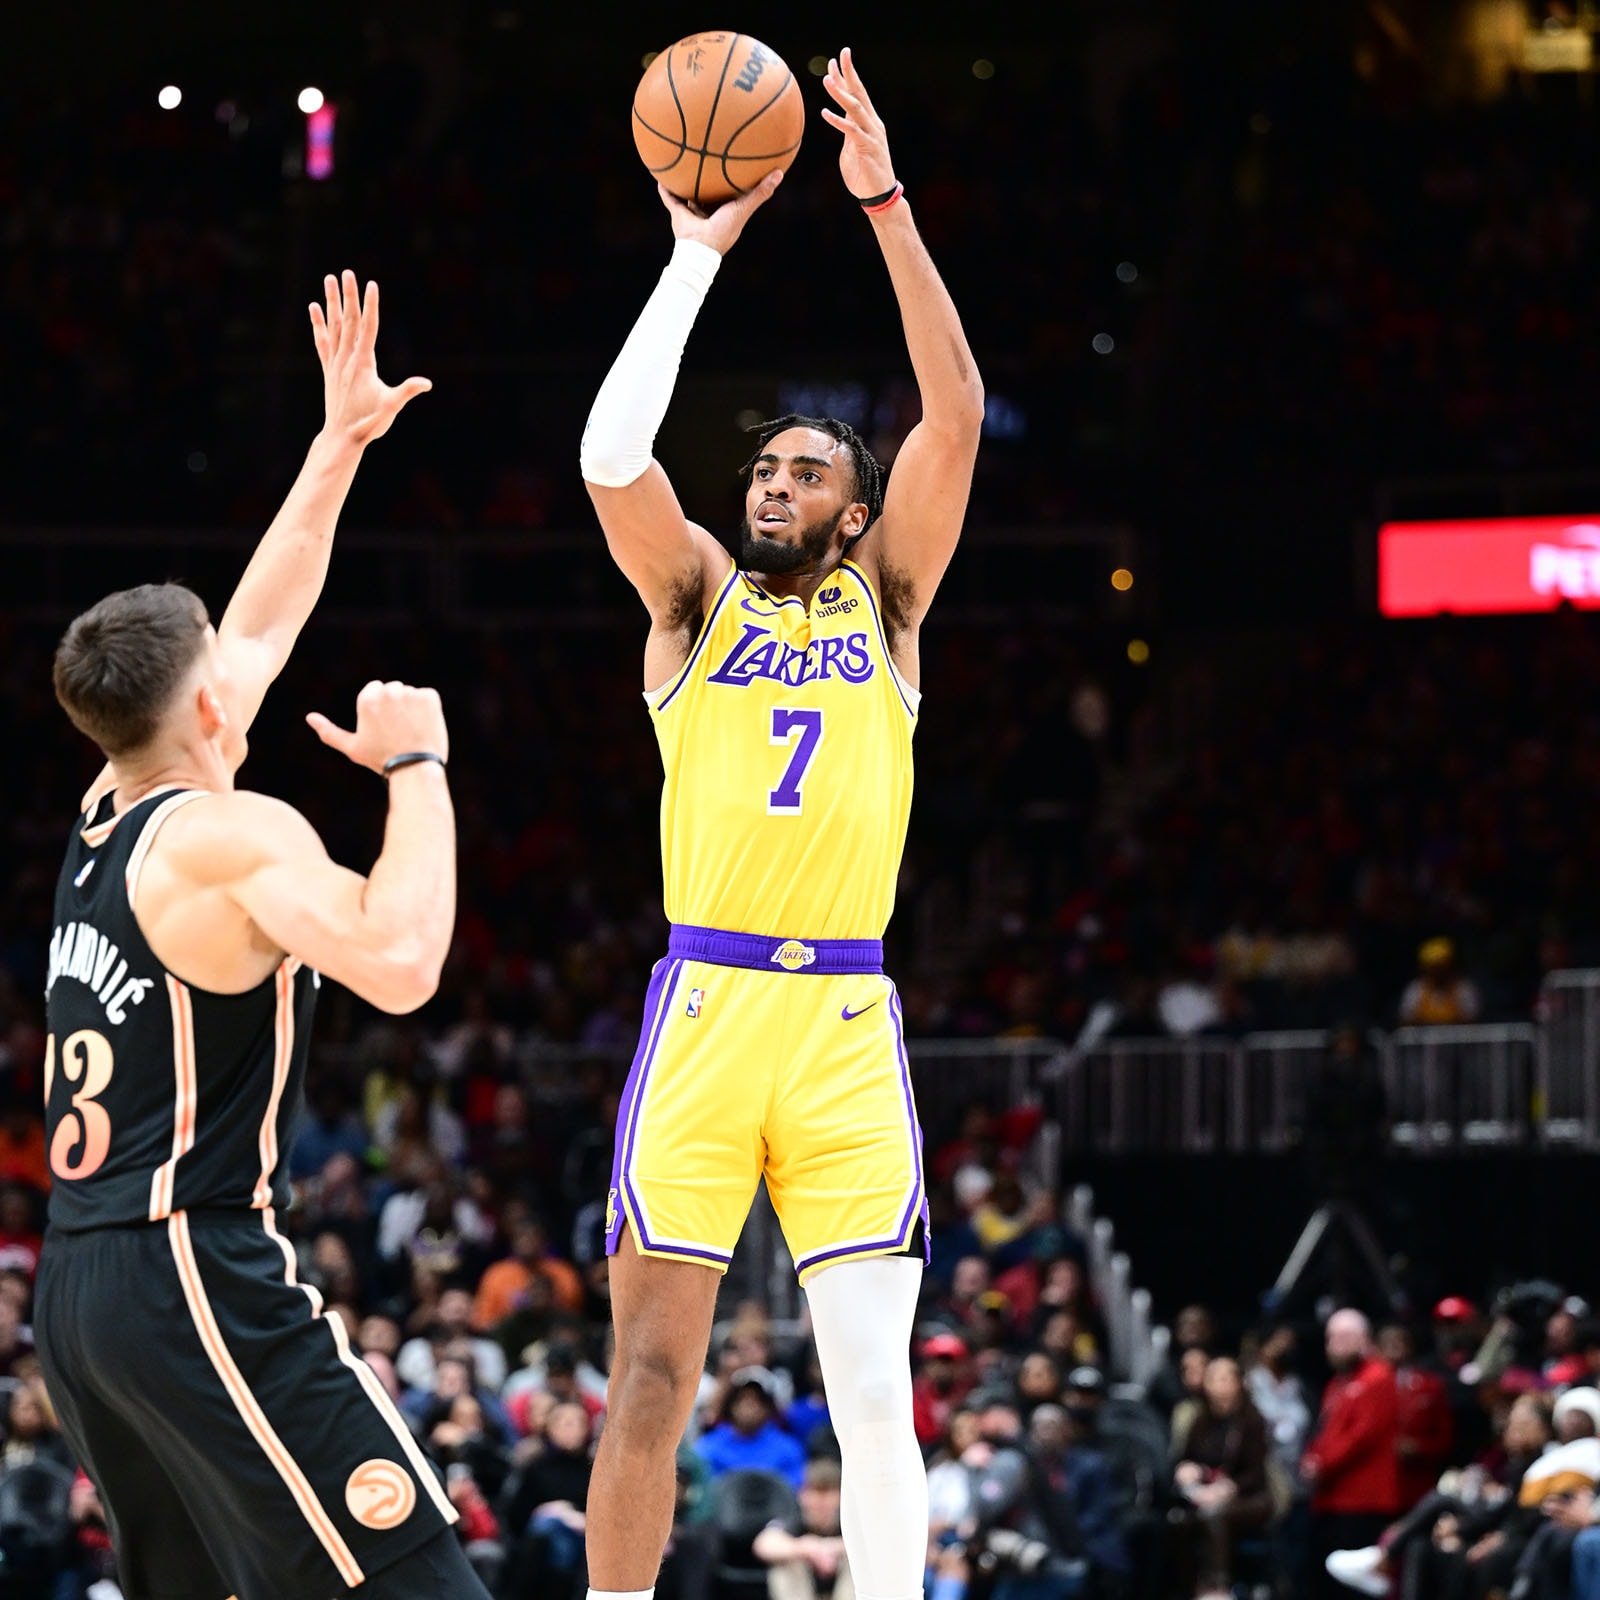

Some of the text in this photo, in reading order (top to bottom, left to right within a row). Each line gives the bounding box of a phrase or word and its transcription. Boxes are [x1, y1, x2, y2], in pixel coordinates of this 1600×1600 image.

[815, 599, 859, 619] bibigo
[706, 623, 875, 687] LAKERS
[767, 706, 824, 816] 7
